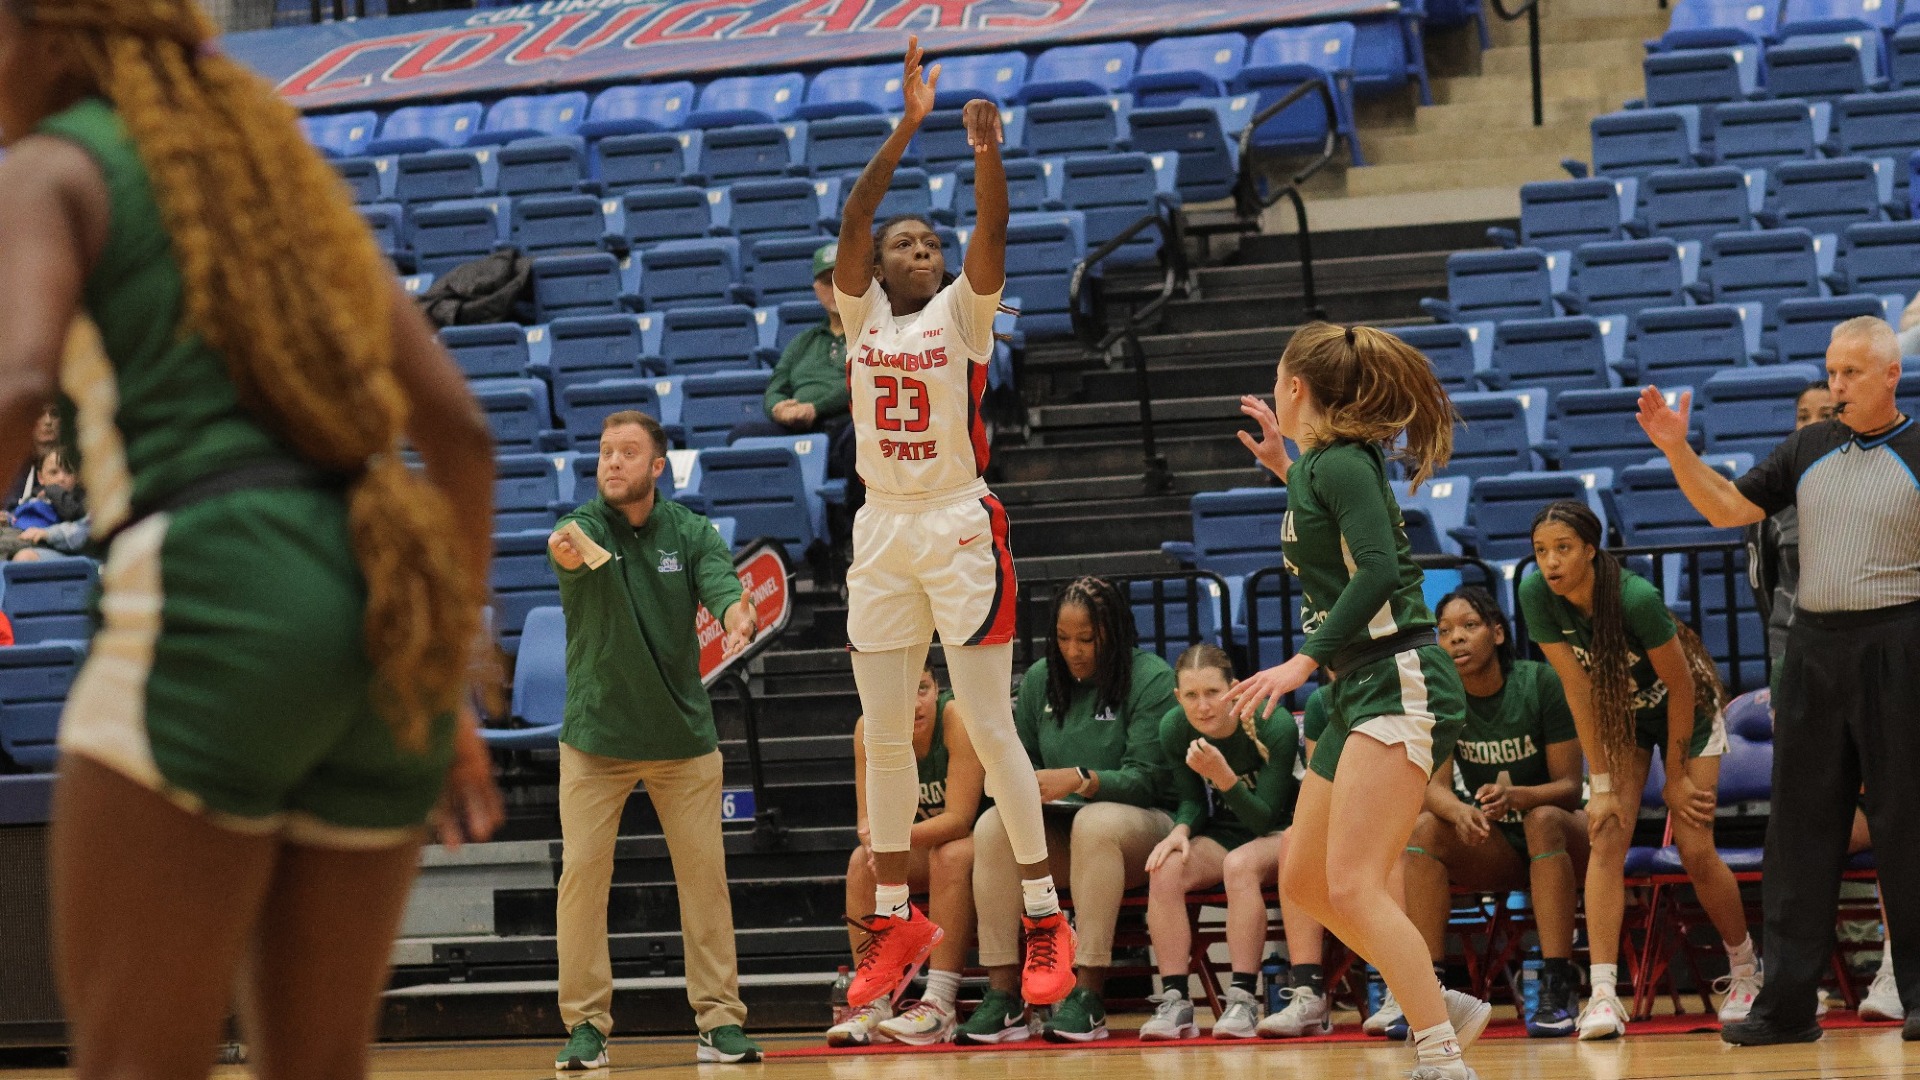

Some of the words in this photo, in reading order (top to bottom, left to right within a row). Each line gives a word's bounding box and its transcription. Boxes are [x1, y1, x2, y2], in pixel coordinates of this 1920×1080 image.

[922, 328, 944, 339] PBC
[874, 375, 931, 433] 23
[878, 438, 938, 461] STATE
[1456, 734, 1538, 765] GEORGIA
